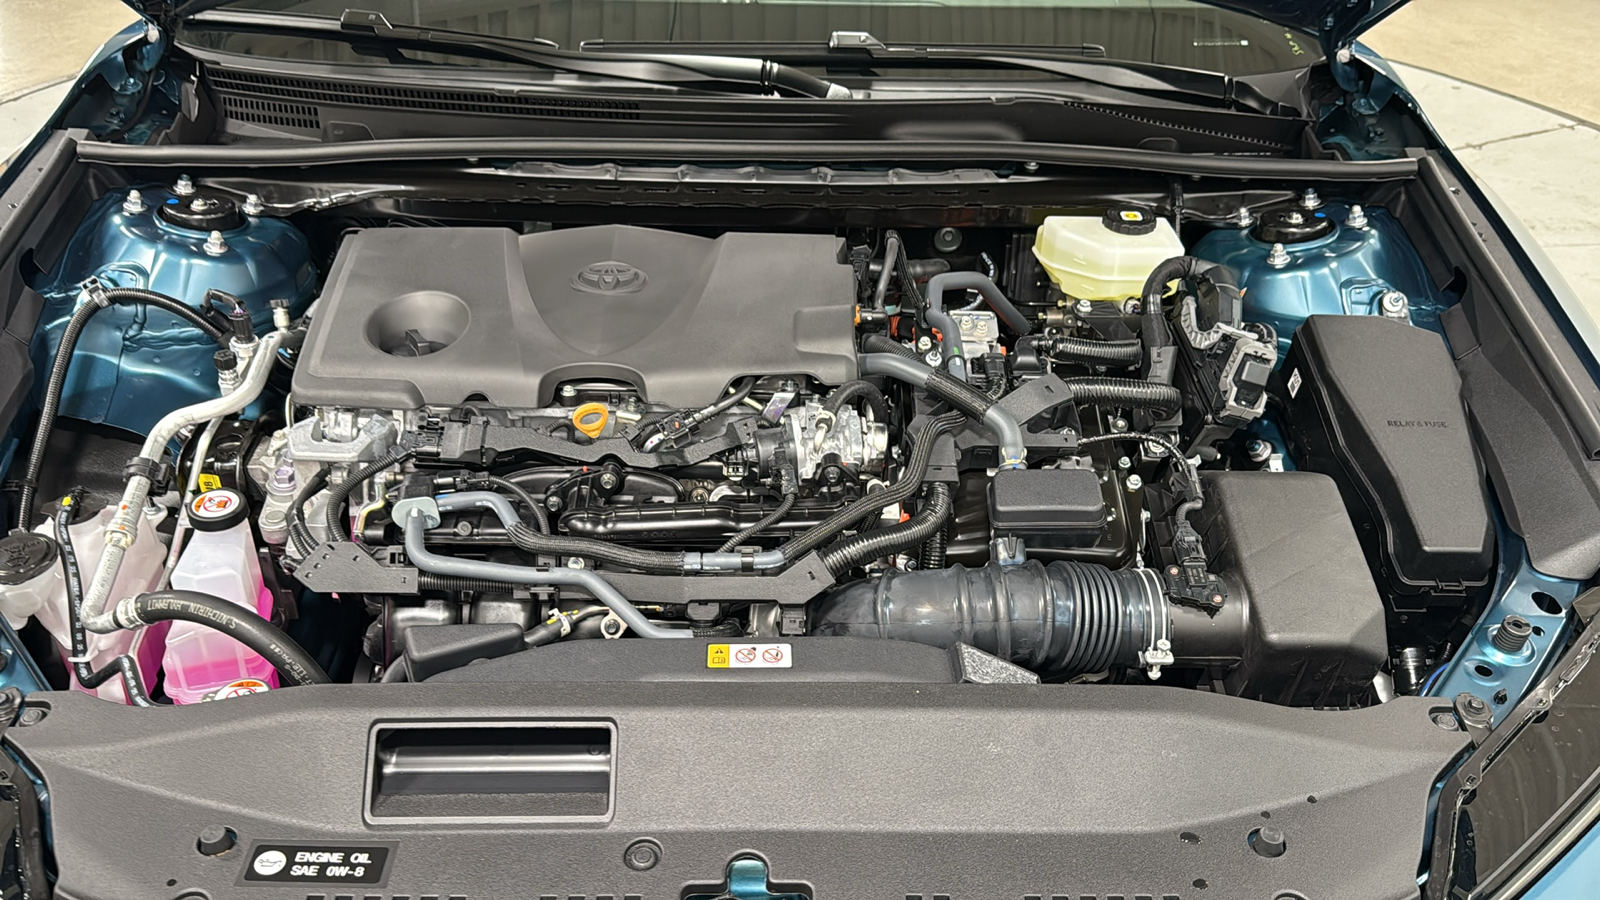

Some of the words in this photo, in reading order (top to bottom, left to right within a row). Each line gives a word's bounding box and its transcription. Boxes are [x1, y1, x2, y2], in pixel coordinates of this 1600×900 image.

[1387, 420, 1415, 428] RELAY
[1424, 421, 1448, 429] FUSE
[294, 851, 345, 863] ENGINE
[349, 852, 372, 864] OIL
[289, 864, 320, 877] SAE
[325, 865, 366, 878] 0W-8
